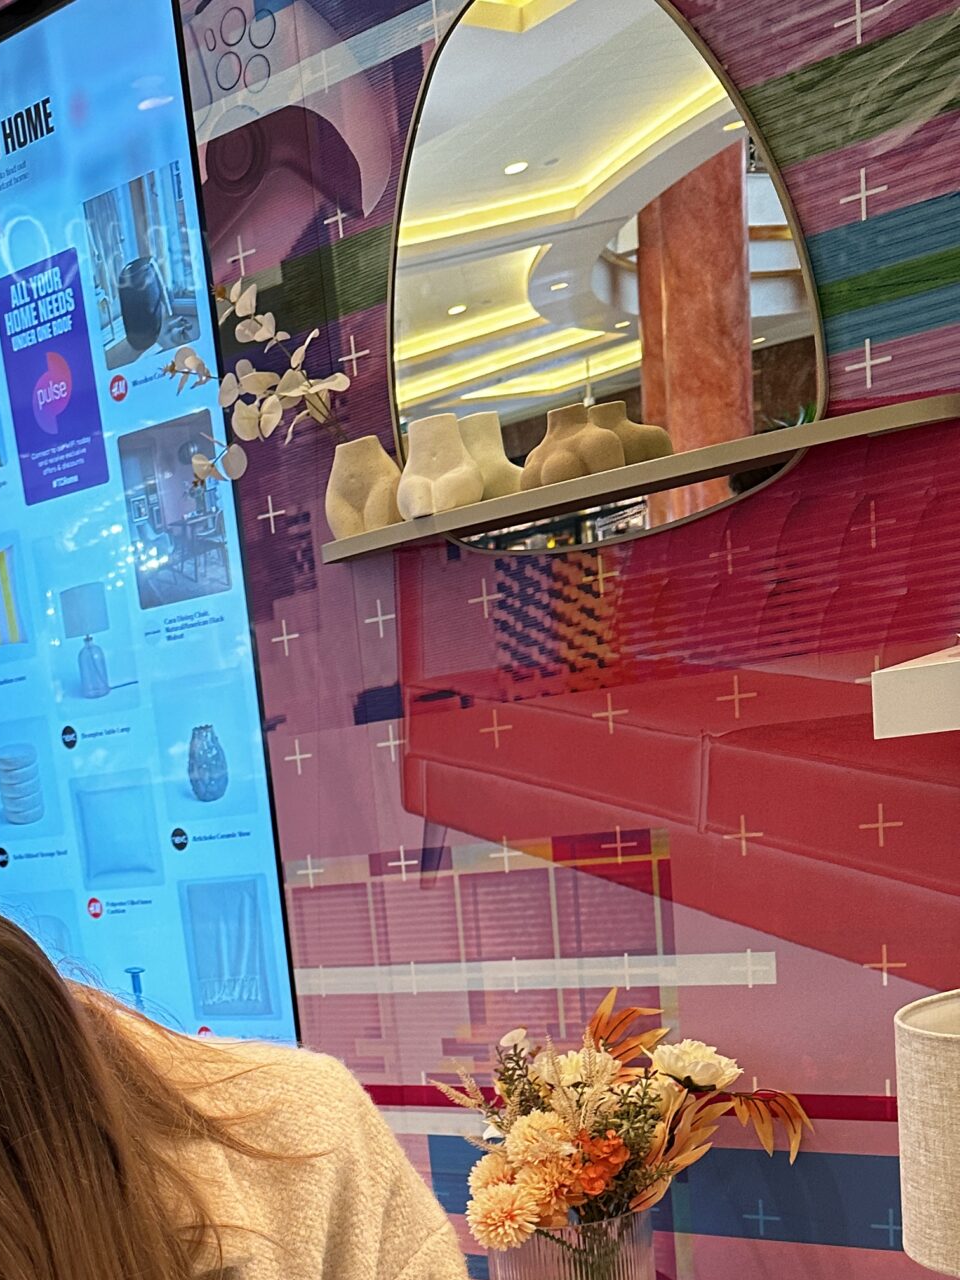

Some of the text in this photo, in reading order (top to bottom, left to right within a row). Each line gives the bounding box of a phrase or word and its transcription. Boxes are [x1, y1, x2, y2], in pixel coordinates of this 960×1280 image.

[1, 97, 55, 155] HOME
[10, 267, 62, 308] ALL YOUR
[4, 288, 75, 336] HOME NEEDS
[11, 315, 72, 351] UNDER ONE ROOF
[37, 380, 67, 410] pulse
